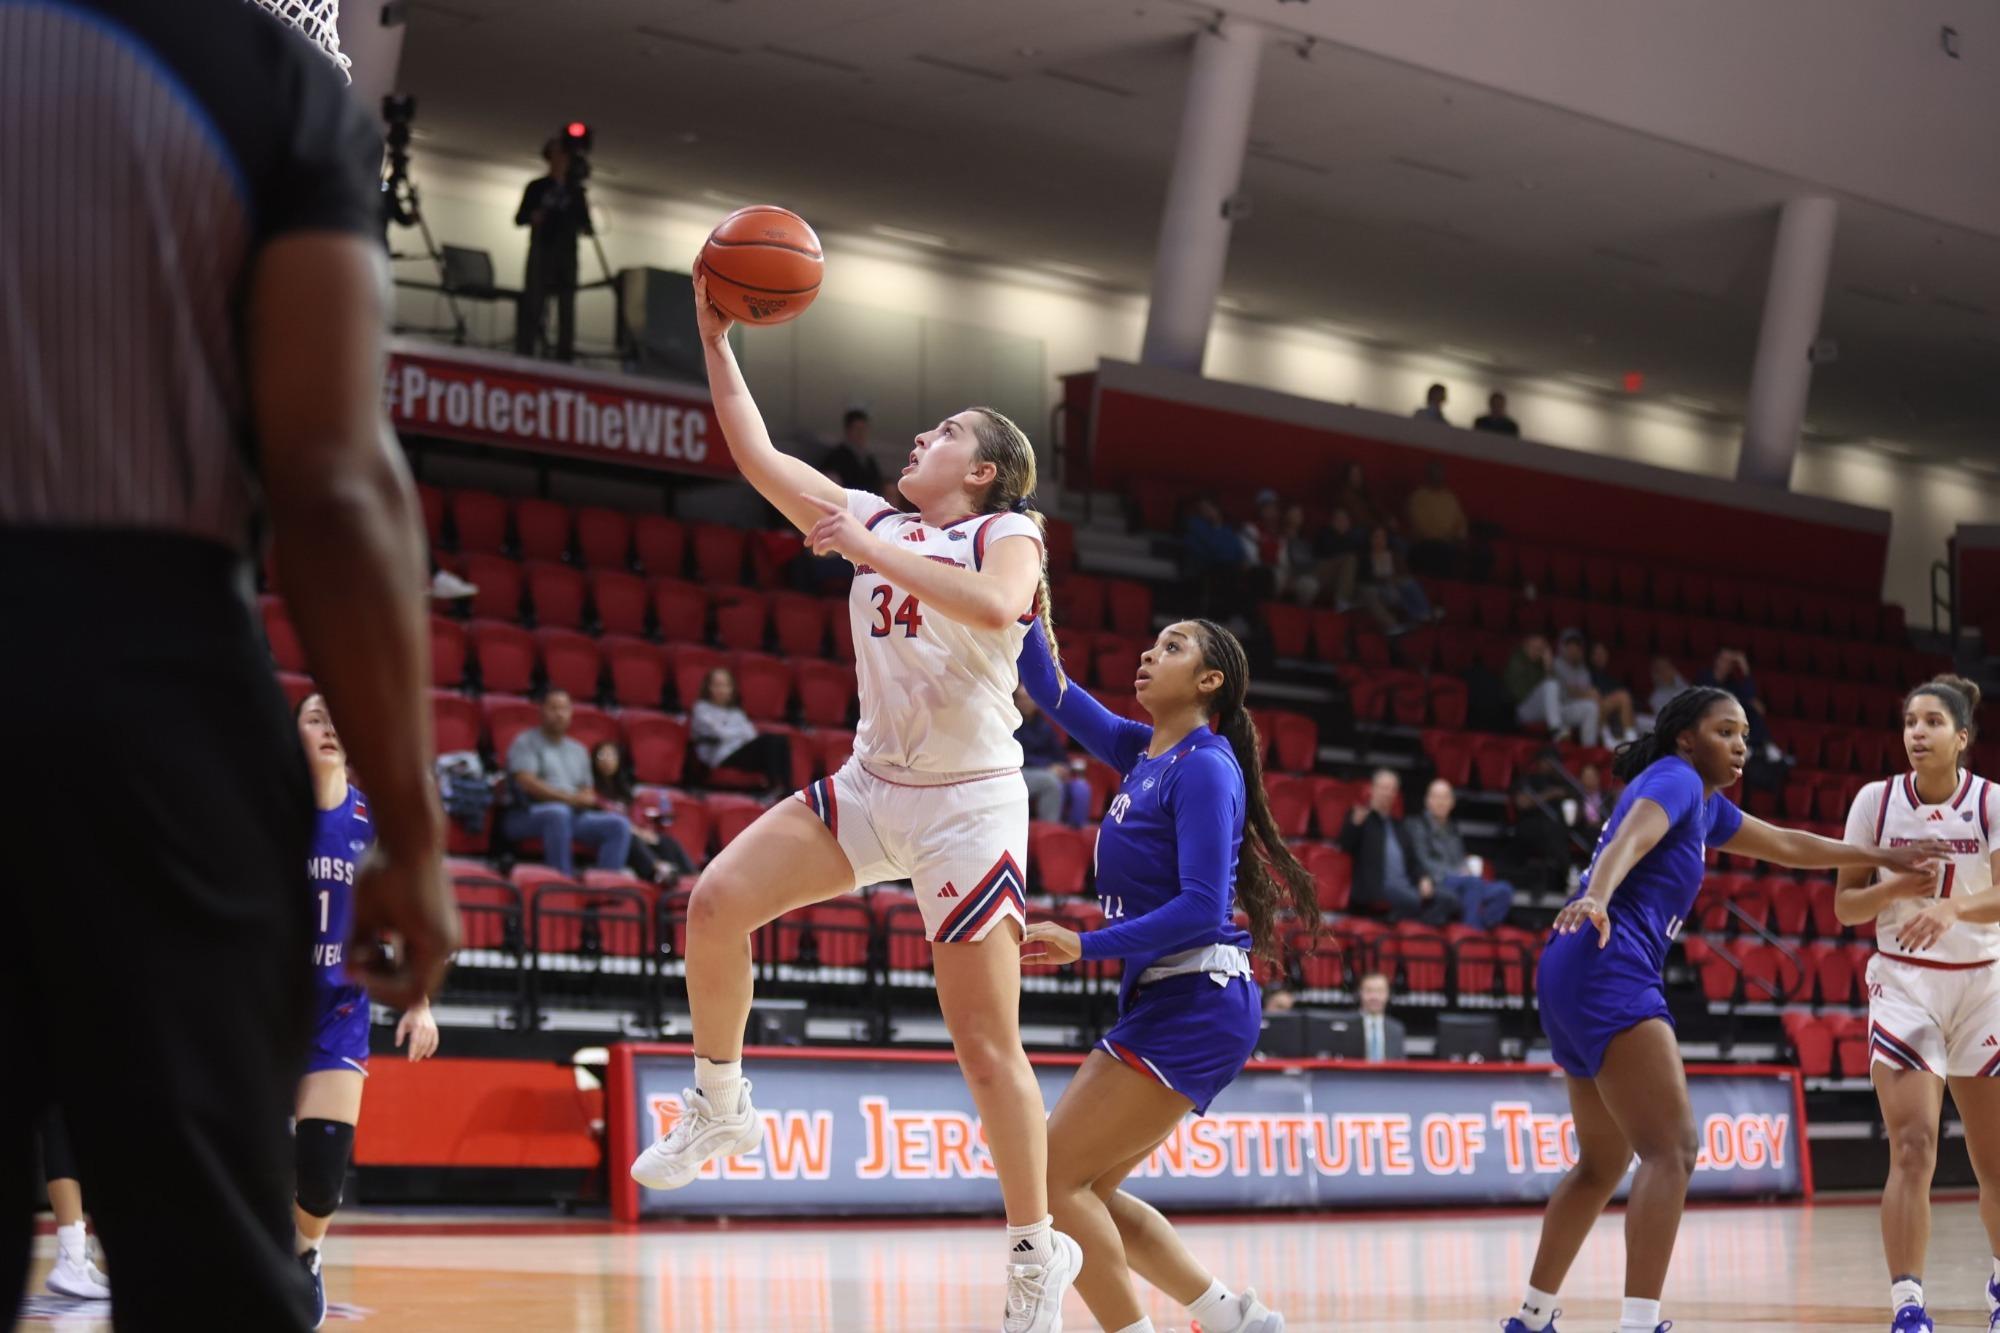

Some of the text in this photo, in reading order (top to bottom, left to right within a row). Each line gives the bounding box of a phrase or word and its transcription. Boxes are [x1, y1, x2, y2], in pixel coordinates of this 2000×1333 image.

[871, 584, 922, 638] 34
[307, 856, 355, 886] MASS
[318, 890, 329, 933] 1
[1127, 1112, 1415, 1178] NSTITUTE
[1420, 1112, 1486, 1176] OF
[1491, 1102, 1790, 1174] TECOGY
